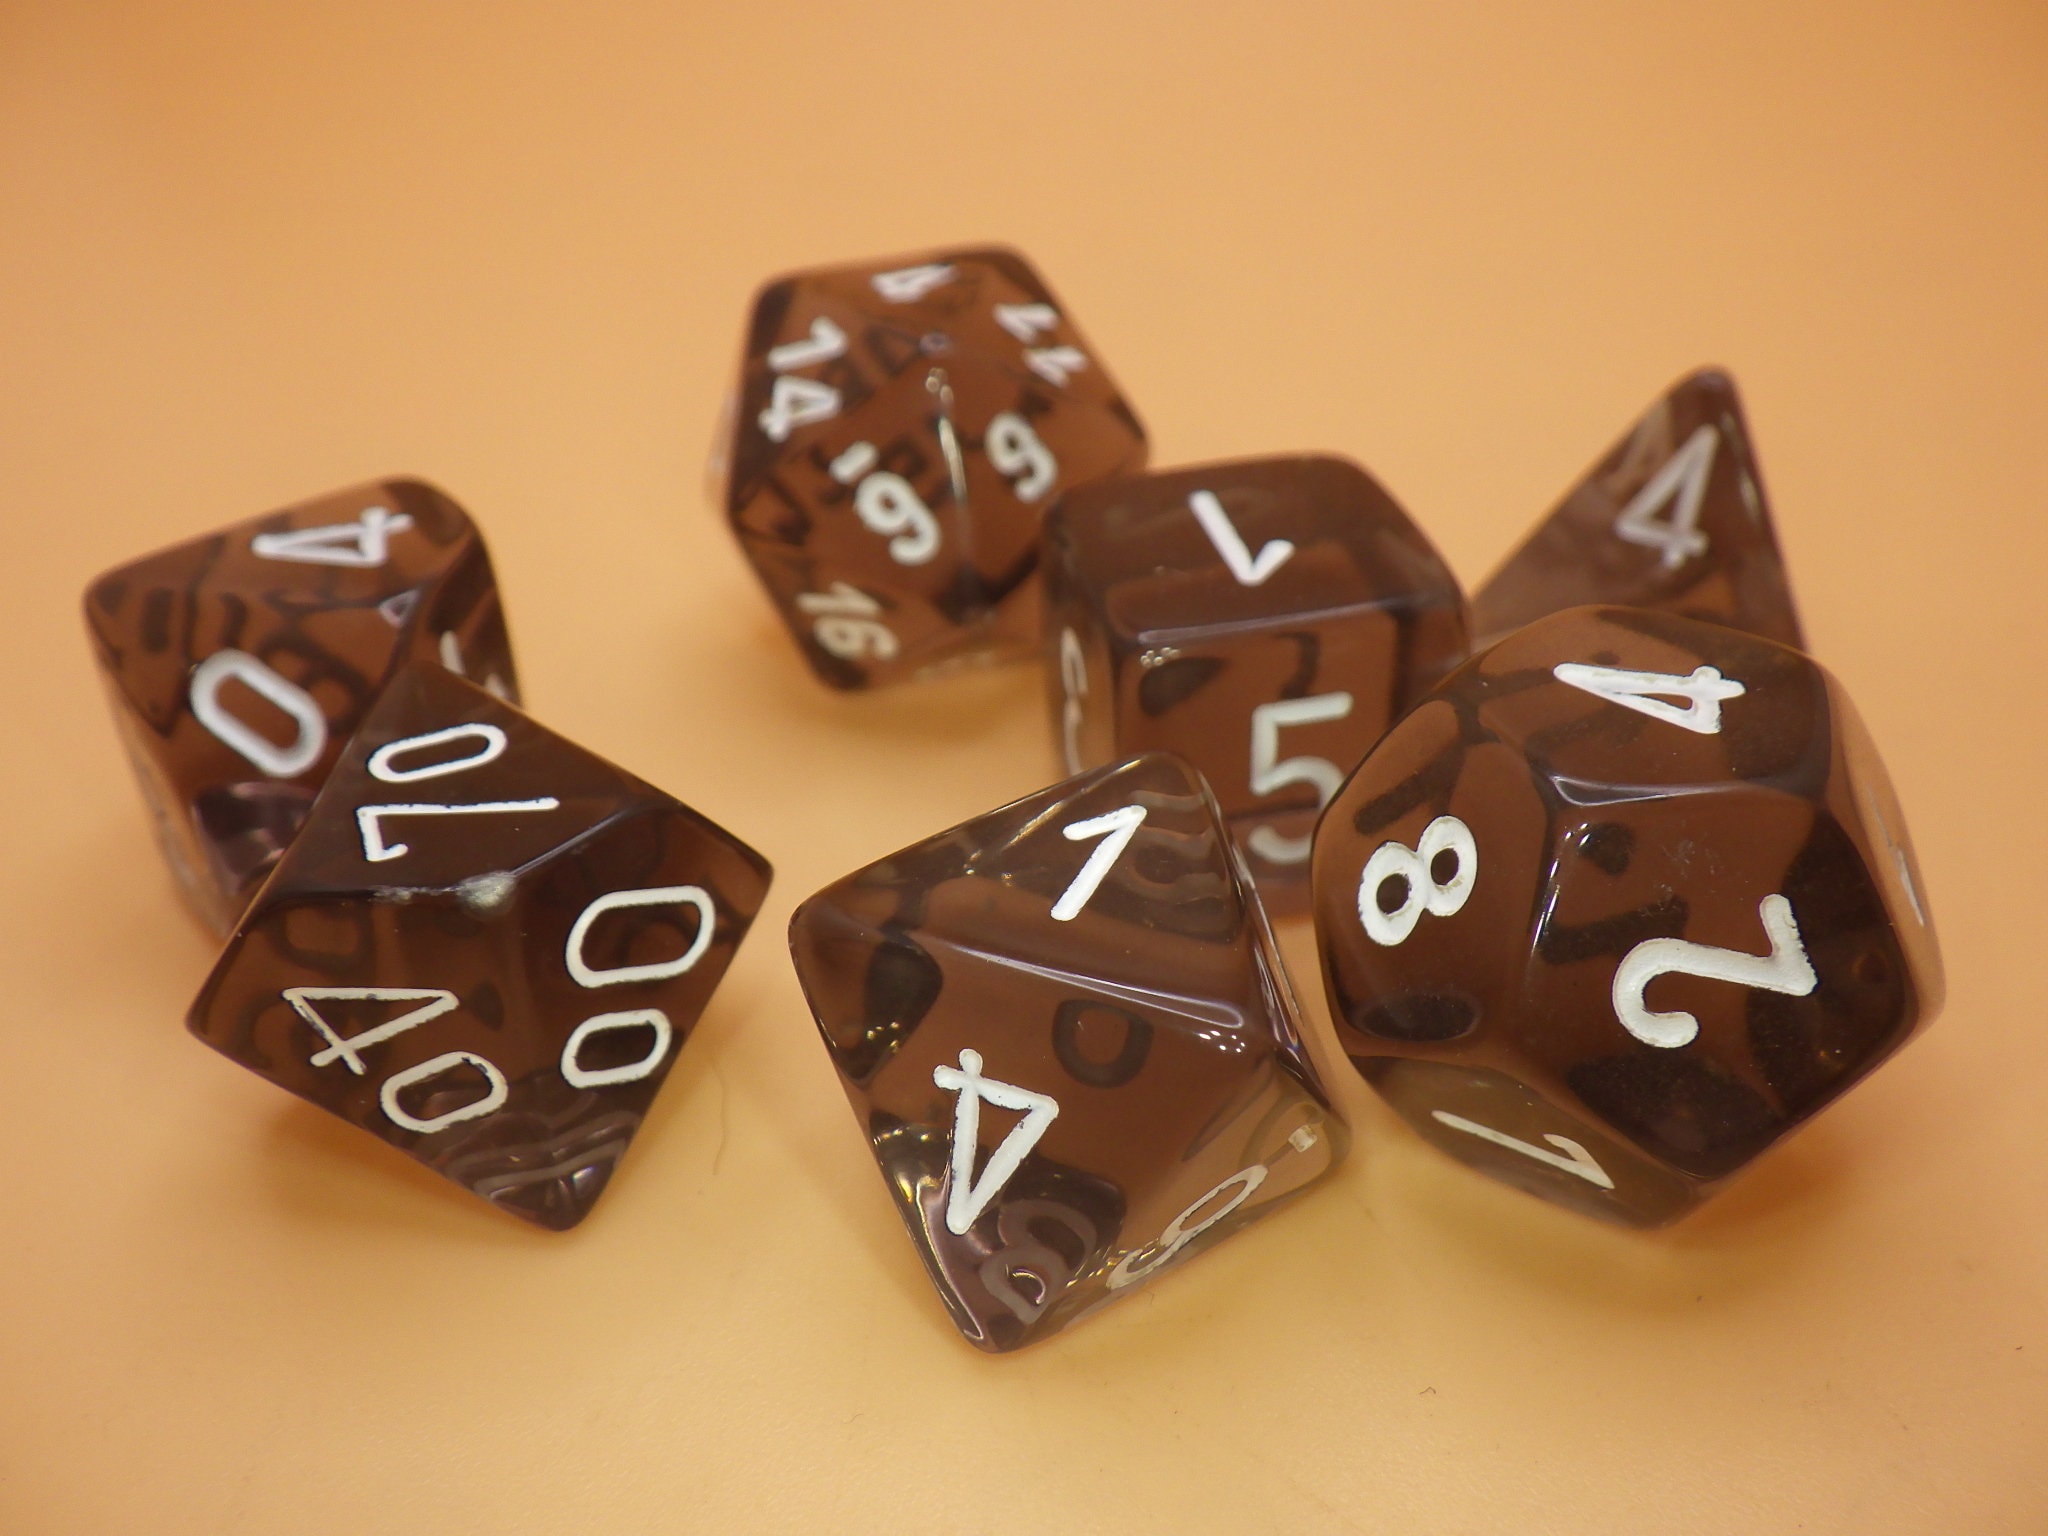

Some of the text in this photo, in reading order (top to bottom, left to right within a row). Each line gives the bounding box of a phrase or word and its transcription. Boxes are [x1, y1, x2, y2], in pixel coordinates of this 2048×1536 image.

[758, 316, 848, 443] 14
[250, 506, 413, 568] 4
[1189, 489, 1296, 587] 1
[1613, 424, 1719, 569] 4
[189, 649, 327, 778] 0
[1553, 662, 1748, 735] 4
[355, 722, 561, 862] 70
[1248, 690, 1354, 864] 5
[1050, 804, 1147, 922] 1
[1358, 814, 1479, 947] 8
[560, 885, 716, 1089] 00
[1611, 893, 1819, 1049] 2
[282, 986, 509, 1134] 40
[932, 1048, 1060, 1236] 4
